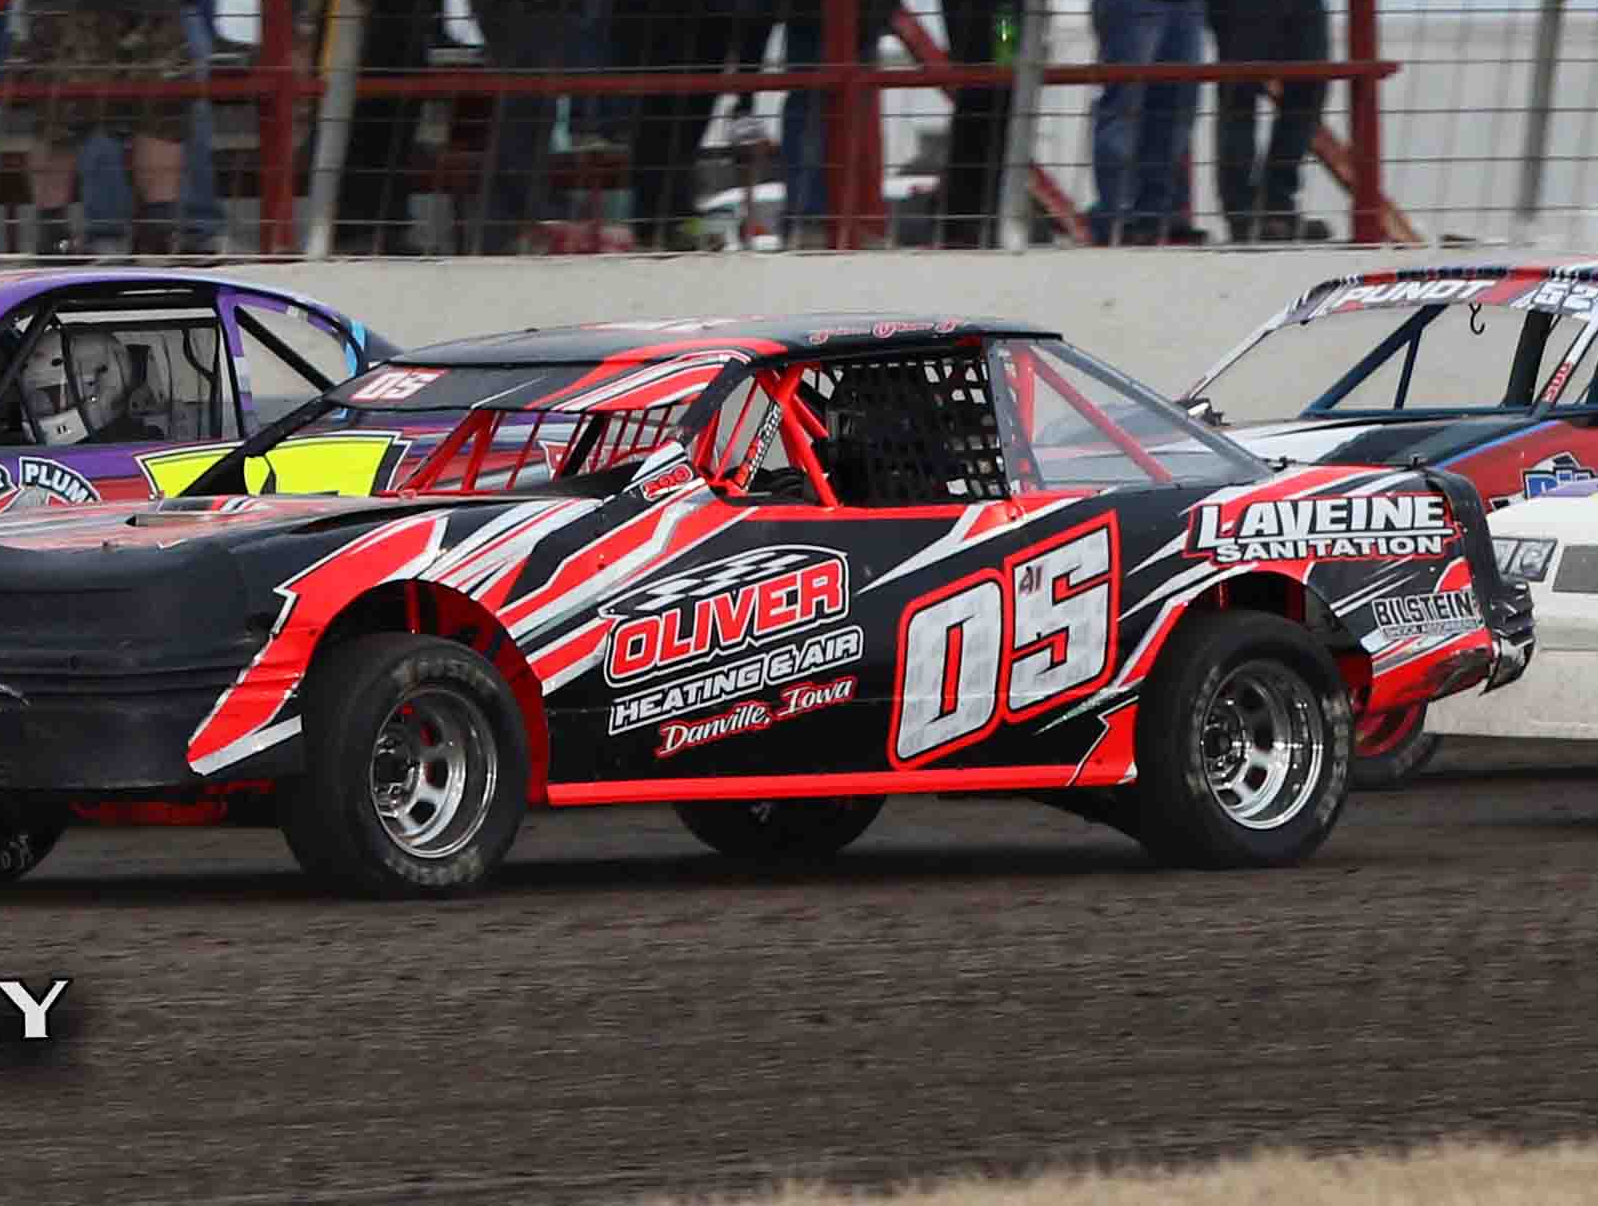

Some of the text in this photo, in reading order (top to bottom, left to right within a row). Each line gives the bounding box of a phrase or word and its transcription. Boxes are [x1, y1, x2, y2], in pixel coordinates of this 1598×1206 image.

[24, 463, 98, 503] PLUM
[1197, 496, 1446, 548] LAVEINE
[1215, 534, 1442, 565] SANITATION
[609, 557, 845, 678] OLIVER
[1373, 591, 1478, 628] BILSTEIN
[896, 524, 1114, 762] 05
[613, 631, 860, 728] HEATING & AIR
[656, 678, 856, 756] Danville, Iowa
